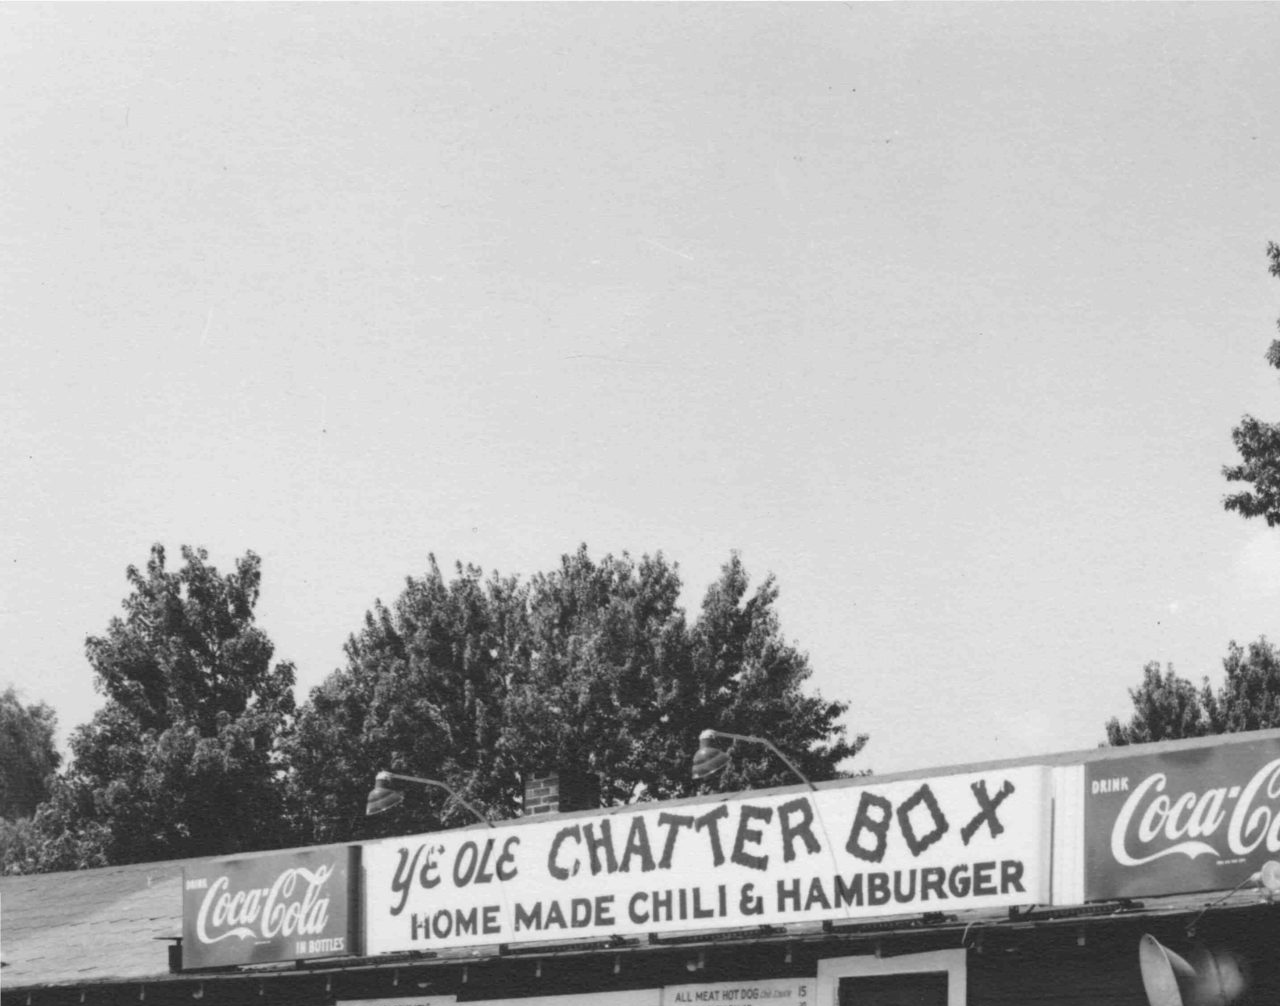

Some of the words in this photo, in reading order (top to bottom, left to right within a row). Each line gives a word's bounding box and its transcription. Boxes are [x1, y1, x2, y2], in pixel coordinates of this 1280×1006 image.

[1092, 777, 1129, 794] DRINK
[453, 836, 520, 888] OLE
[548, 797, 822, 881] CHATTER
[846, 779, 1015, 863] BOX
[197, 863, 335, 944] Coca-Cola
[411, 906, 501, 941] HOME
[514, 895, 615, 931] MADE
[628, 885, 728, 924] CHILI
[739, 883, 764, 915] &
[777, 860, 1026, 912] HAMBURGER
[296, 942, 306, 955] IN
[309, 937, 344, 954] BOTTLES
[675, 991, 692, 1003] ALL
[696, 989, 720, 1002] MEAT
[722, 989, 739, 1001] HOT
[741, 988, 759, 1000] DOG
